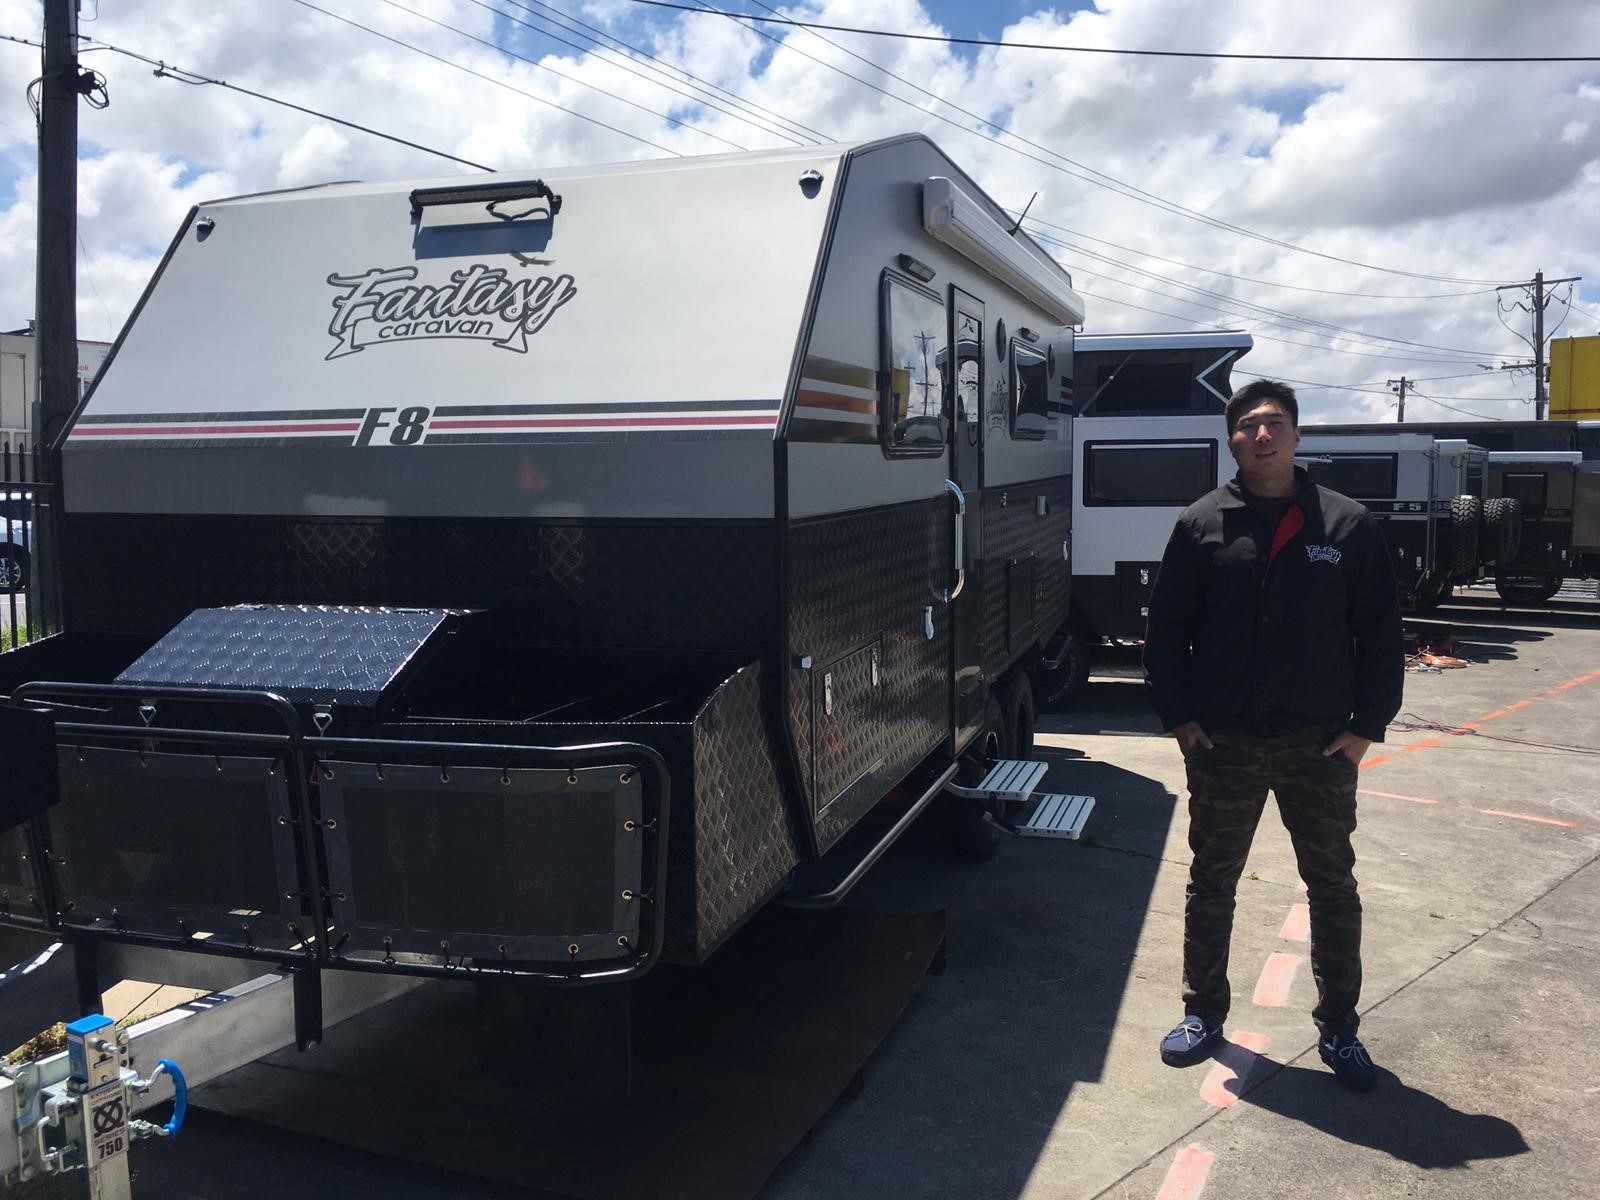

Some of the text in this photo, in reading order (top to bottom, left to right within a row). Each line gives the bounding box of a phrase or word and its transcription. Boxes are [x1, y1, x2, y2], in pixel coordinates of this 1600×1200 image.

[326, 264, 577, 335] Fantasy
[378, 318, 494, 339] caravan
[354, 406, 430, 446] F8
[94, 1127, 126, 1146] SERIES
[98, 1137, 123, 1160] 750
